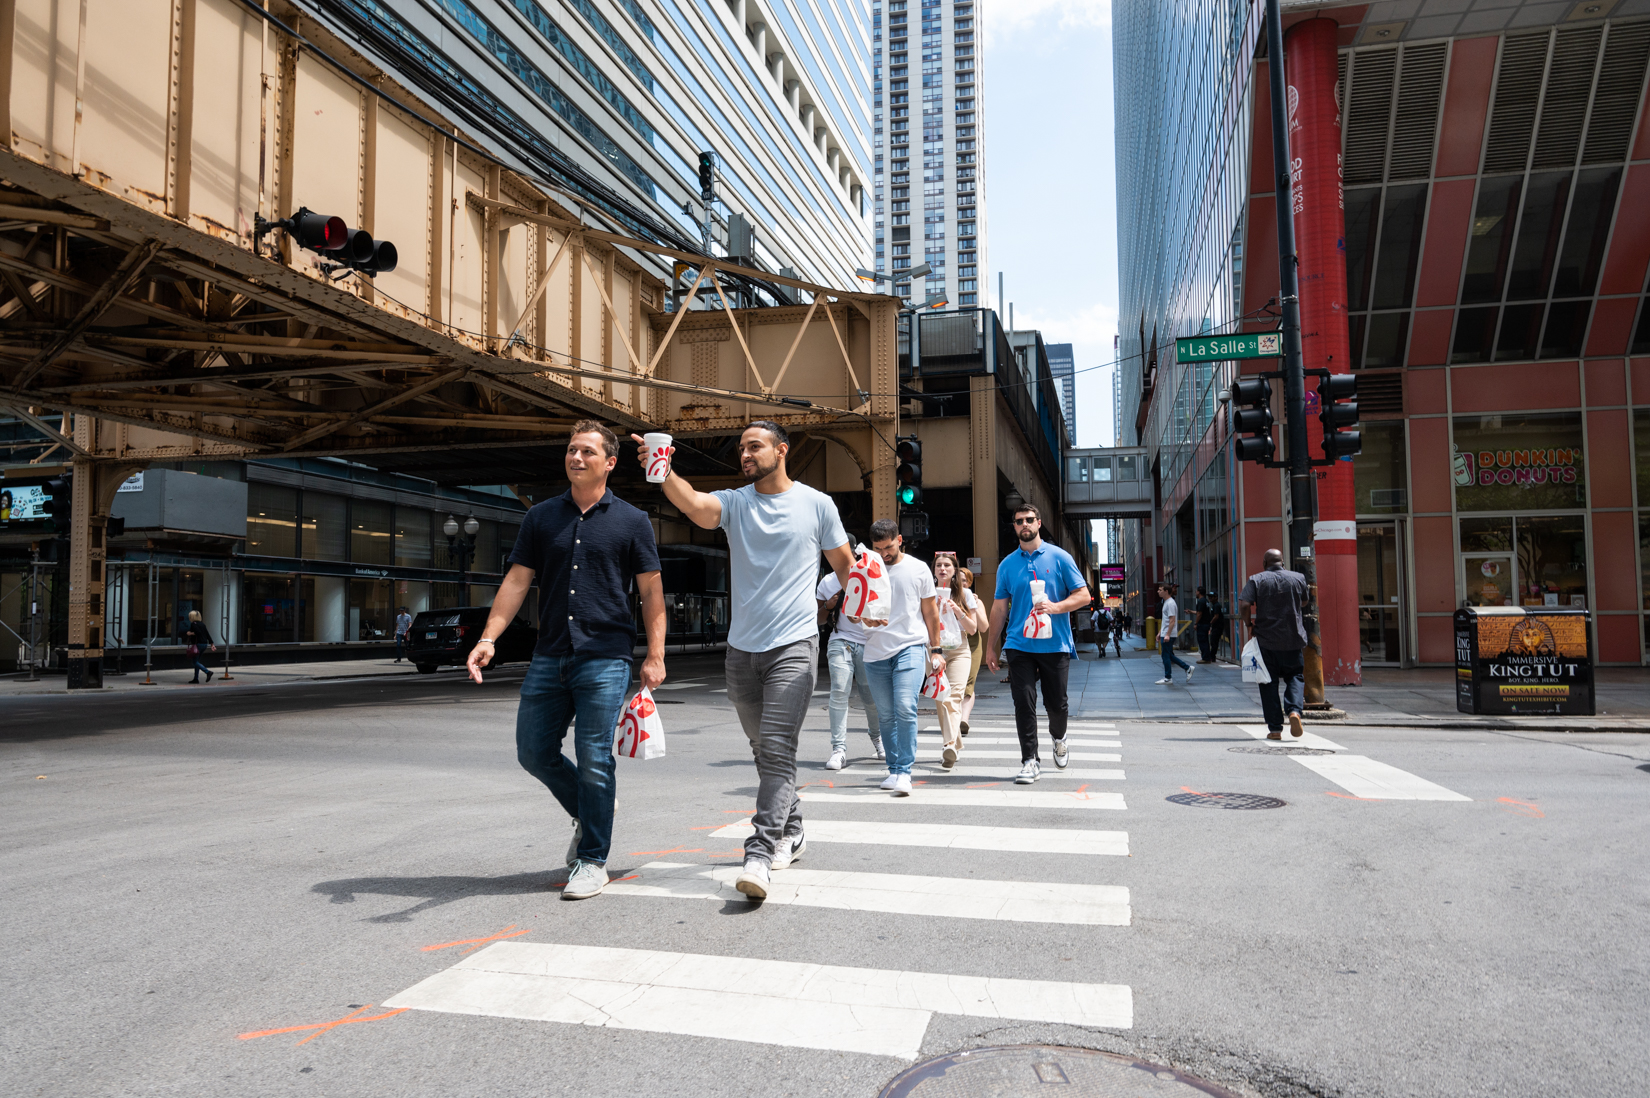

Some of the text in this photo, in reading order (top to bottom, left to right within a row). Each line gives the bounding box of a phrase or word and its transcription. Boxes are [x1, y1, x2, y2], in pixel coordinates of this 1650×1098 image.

[1180, 340, 1257, 356] N La Salle St
[1478, 448, 1580, 468] DUNKIN'
[1478, 466, 1577, 486] DONUTS
[1457, 649, 1471, 661] TUT
[1507, 656, 1559, 664] IMMERSIVE
[1489, 664, 1578, 677] KING TUT
